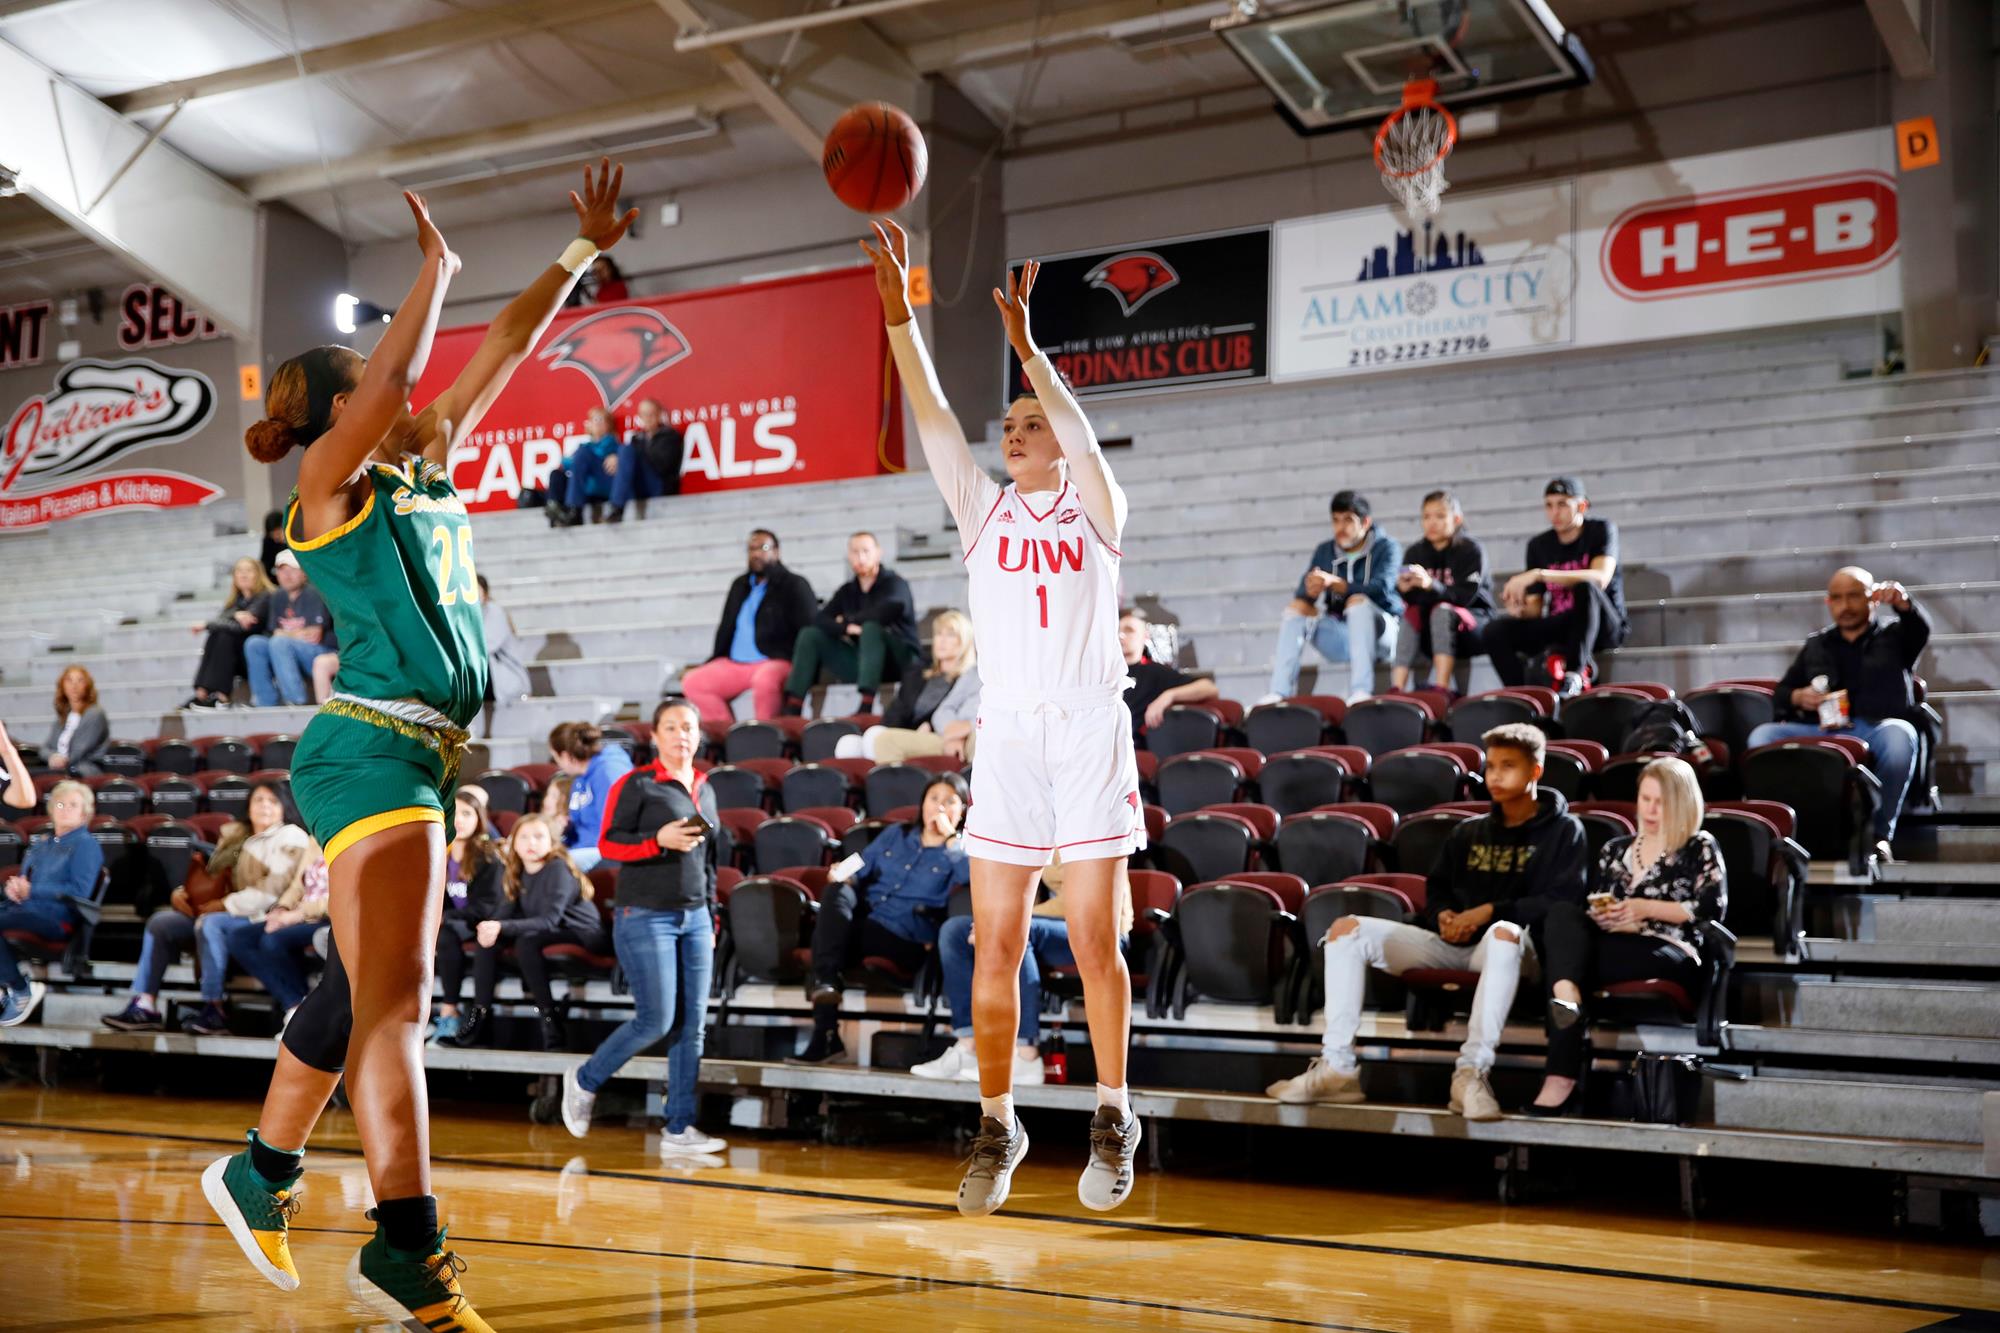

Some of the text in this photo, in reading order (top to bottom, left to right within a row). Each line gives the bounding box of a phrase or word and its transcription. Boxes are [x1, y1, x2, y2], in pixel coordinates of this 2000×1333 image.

[1907, 131, 1930, 158] D
[1638, 197, 1878, 279] H-E-B
[911, 275, 923, 298] C
[1449, 268, 1545, 309] CITY
[1095, 335, 1125, 351] UIW
[1130, 324, 1212, 346] ATHLETICS
[1020, 335, 1253, 392] RDINALS CLUB
[2, 377, 166, 491] Julian's
[552, 421, 575, 440] OF
[739, 395, 797, 418] WORD
[447, 410, 798, 504] CARALS
[40, 487, 98, 520] Pizzeria
[100, 481, 112, 506] &
[114, 479, 172, 504] Kitchen
[432, 524, 479, 606] 25
[997, 535, 1084, 574] UIW
[1036, 584, 1049, 628] 1
